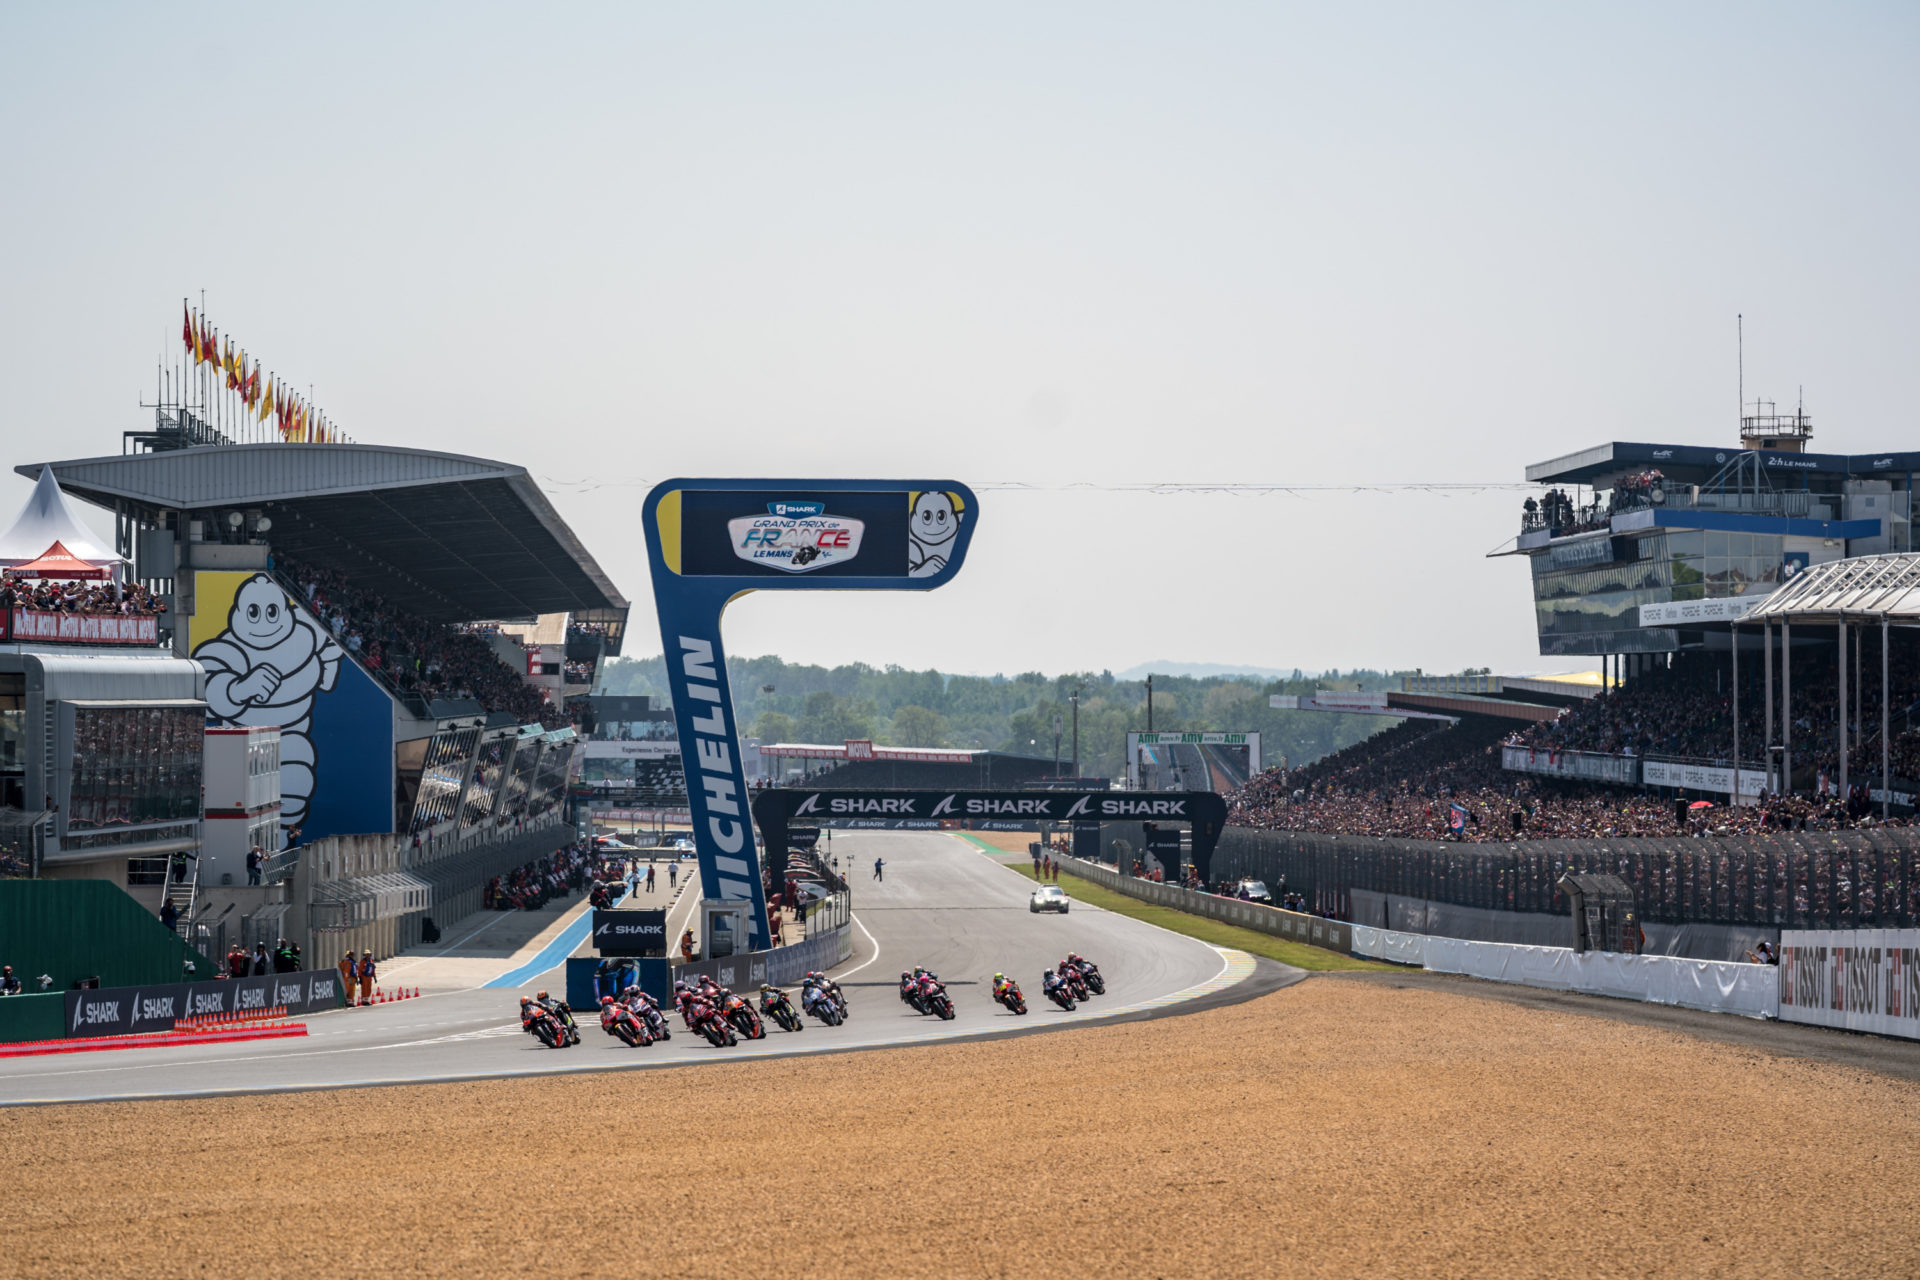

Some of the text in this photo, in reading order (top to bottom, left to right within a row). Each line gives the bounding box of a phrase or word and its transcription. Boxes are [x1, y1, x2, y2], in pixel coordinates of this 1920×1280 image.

[753, 520, 797, 528] GRAND
[798, 520, 828, 528] PRIX
[741, 528, 851, 548] FRANCE
[753, 550, 794, 558] LE MANS
[847, 743, 872, 759] MOTUL
[679, 635, 758, 935] MICHELIN
[830, 798, 1186, 815] SHARK SHARK SHARK
[615, 924, 663, 935] SHARK
[1794, 947, 1827, 1009] TISSOT
[1844, 946, 1881, 1015] TISSOT
[86, 979, 334, 1024] SHARK SHARK SHARK SHARK SHARK SHARK
